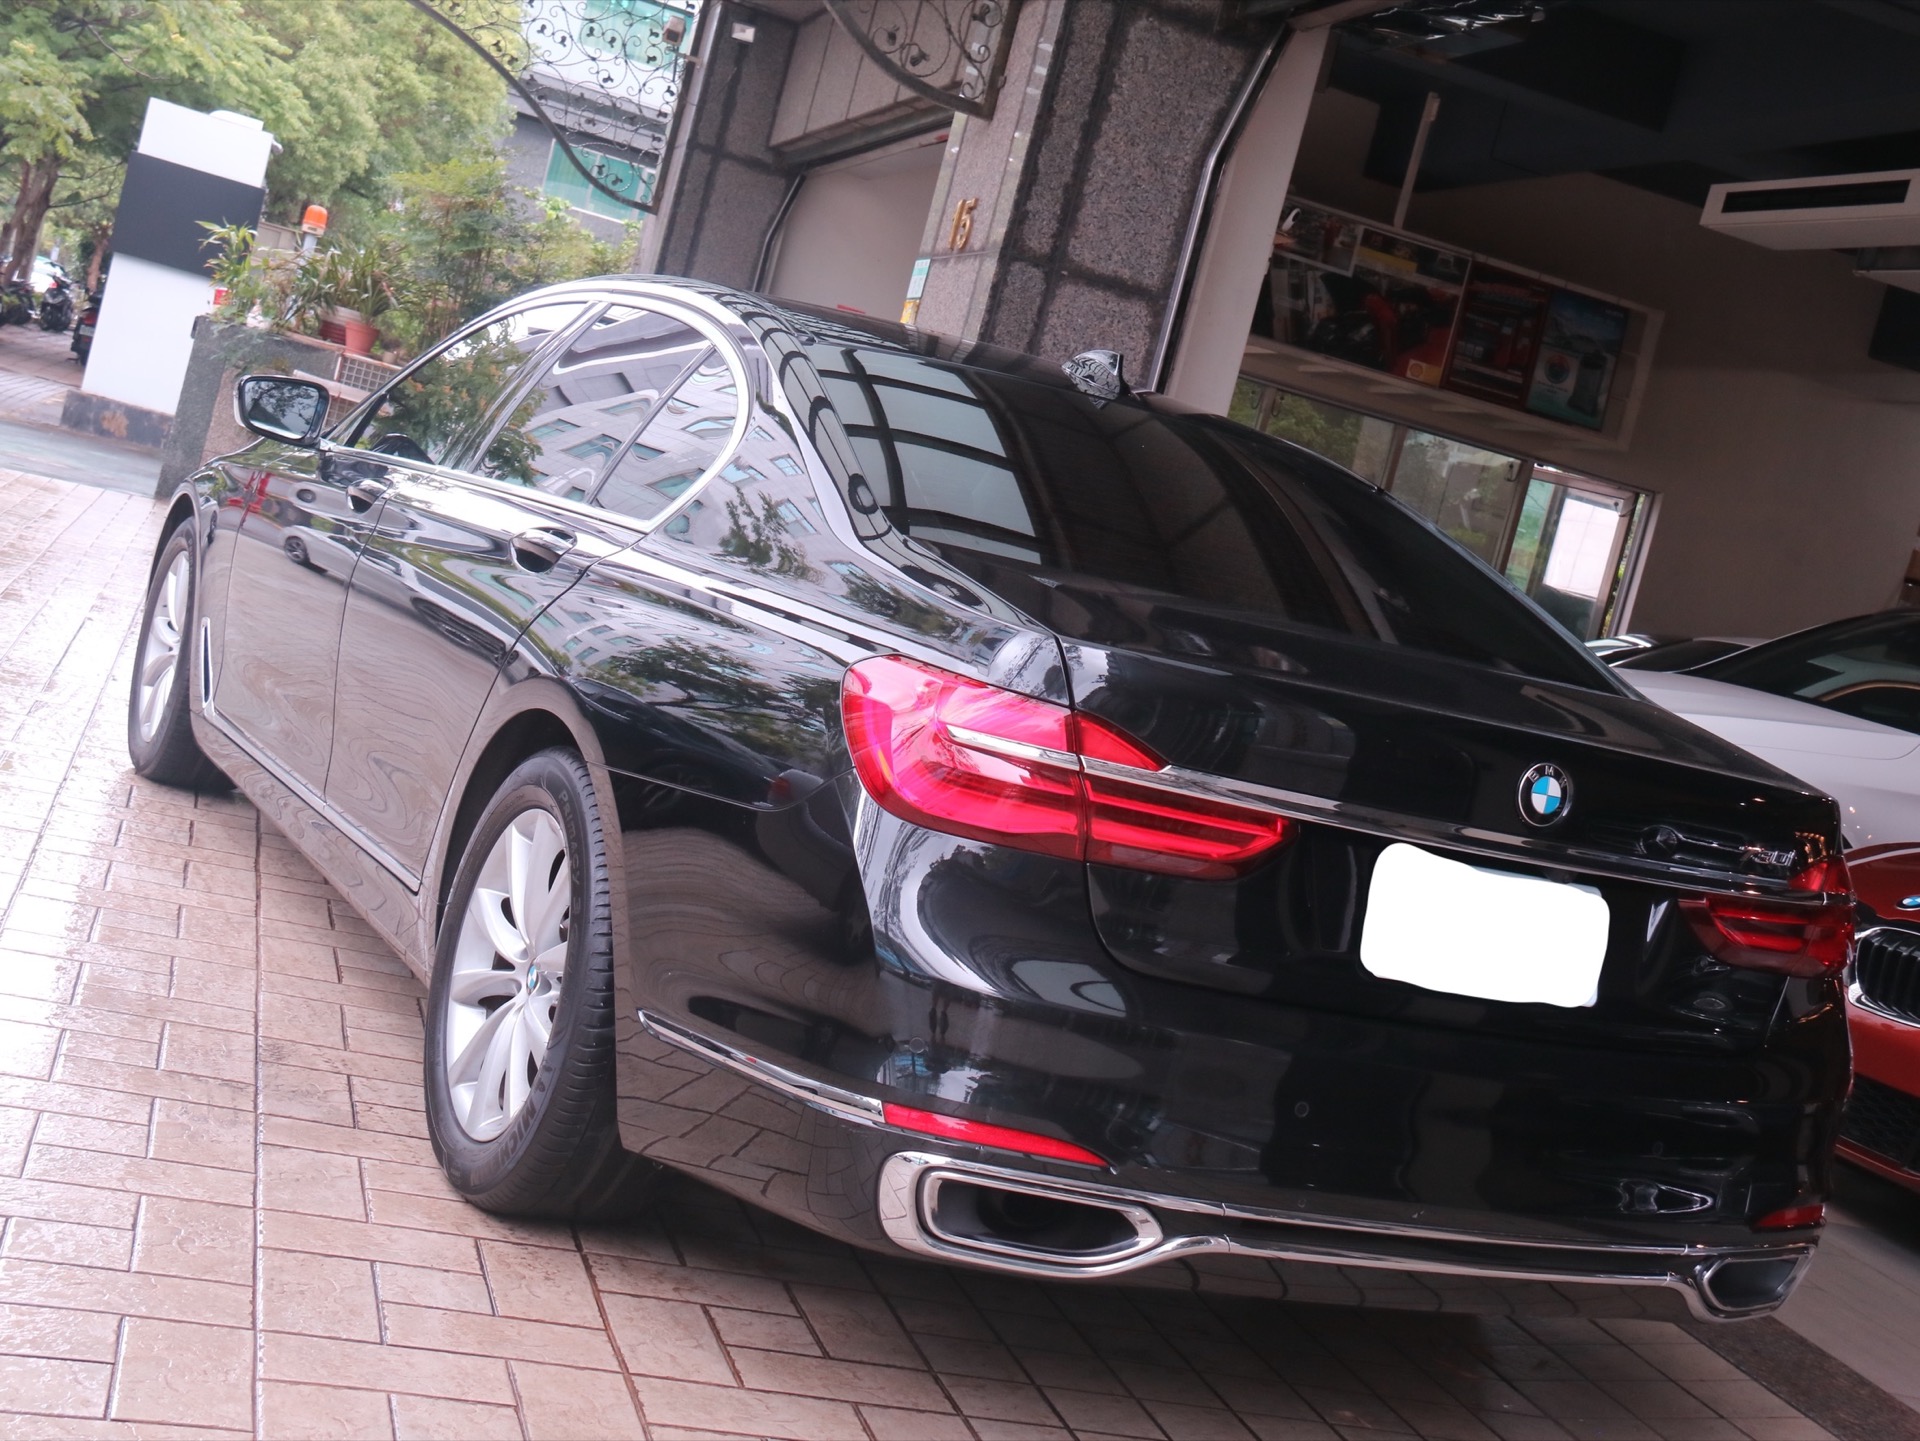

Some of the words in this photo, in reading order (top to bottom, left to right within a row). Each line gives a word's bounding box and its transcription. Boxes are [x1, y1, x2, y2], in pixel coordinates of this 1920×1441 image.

[949, 198, 978, 250] 15
[1527, 765, 1568, 789] BMW
[558, 790, 580, 886] PRIMACY
